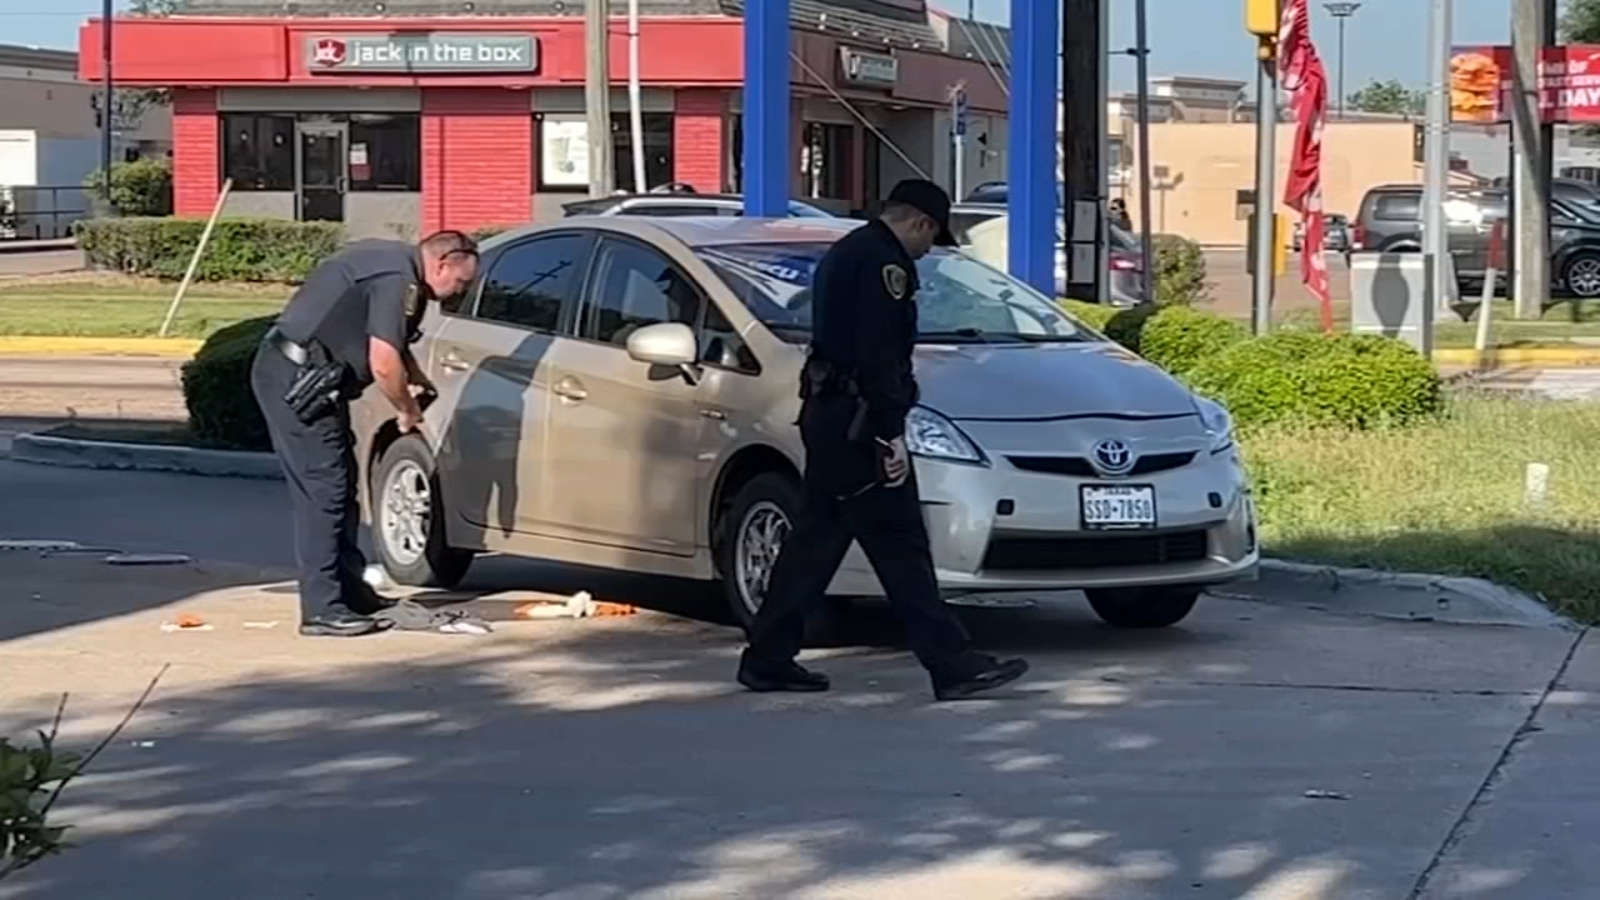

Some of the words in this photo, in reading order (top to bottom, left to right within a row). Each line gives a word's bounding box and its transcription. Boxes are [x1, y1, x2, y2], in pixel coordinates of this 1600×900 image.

[350, 40, 402, 65] jack
[433, 41, 472, 61] the
[477, 39, 522, 61] box
[1558, 87, 1600, 107] DAY
